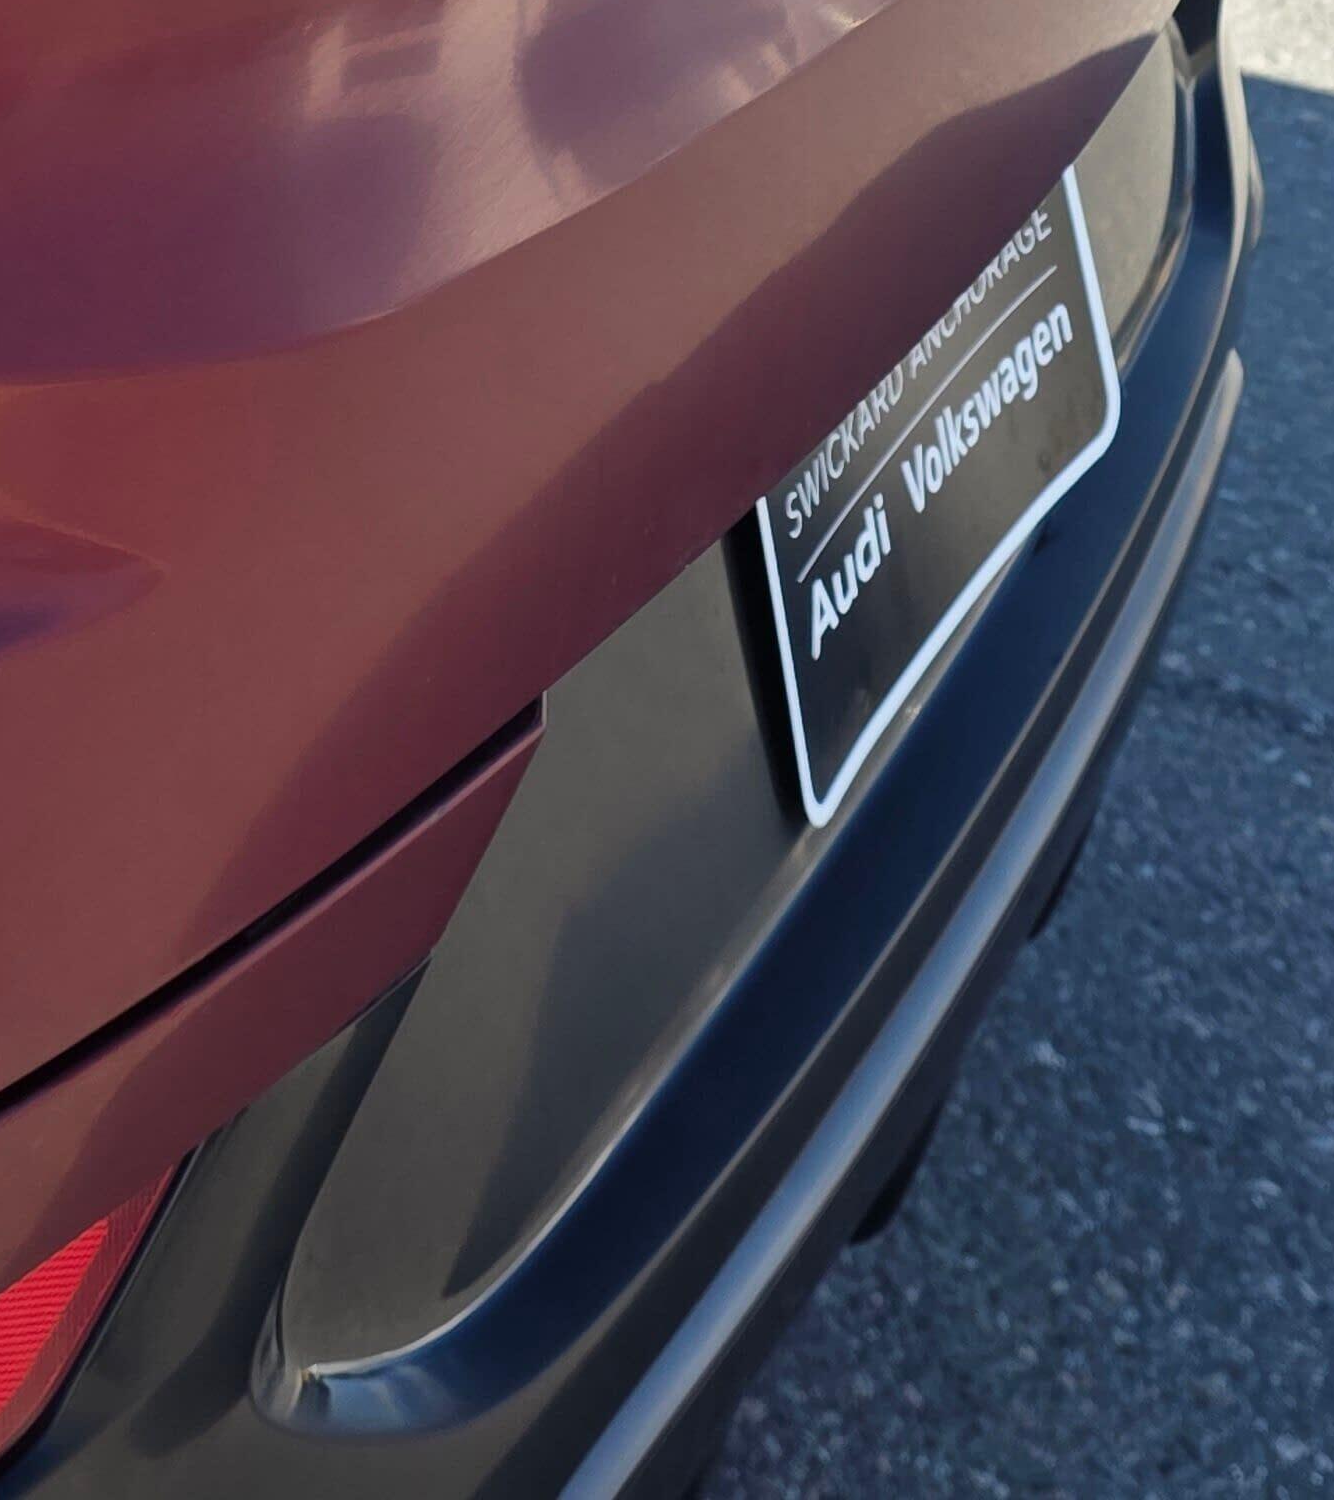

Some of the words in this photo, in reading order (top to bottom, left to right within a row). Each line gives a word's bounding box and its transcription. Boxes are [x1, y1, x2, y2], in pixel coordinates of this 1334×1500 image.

[785, 363, 904, 539] SWICKARD
[810, 492, 892, 660] Audi
[900, 302, 1073, 514] Volkswagen
